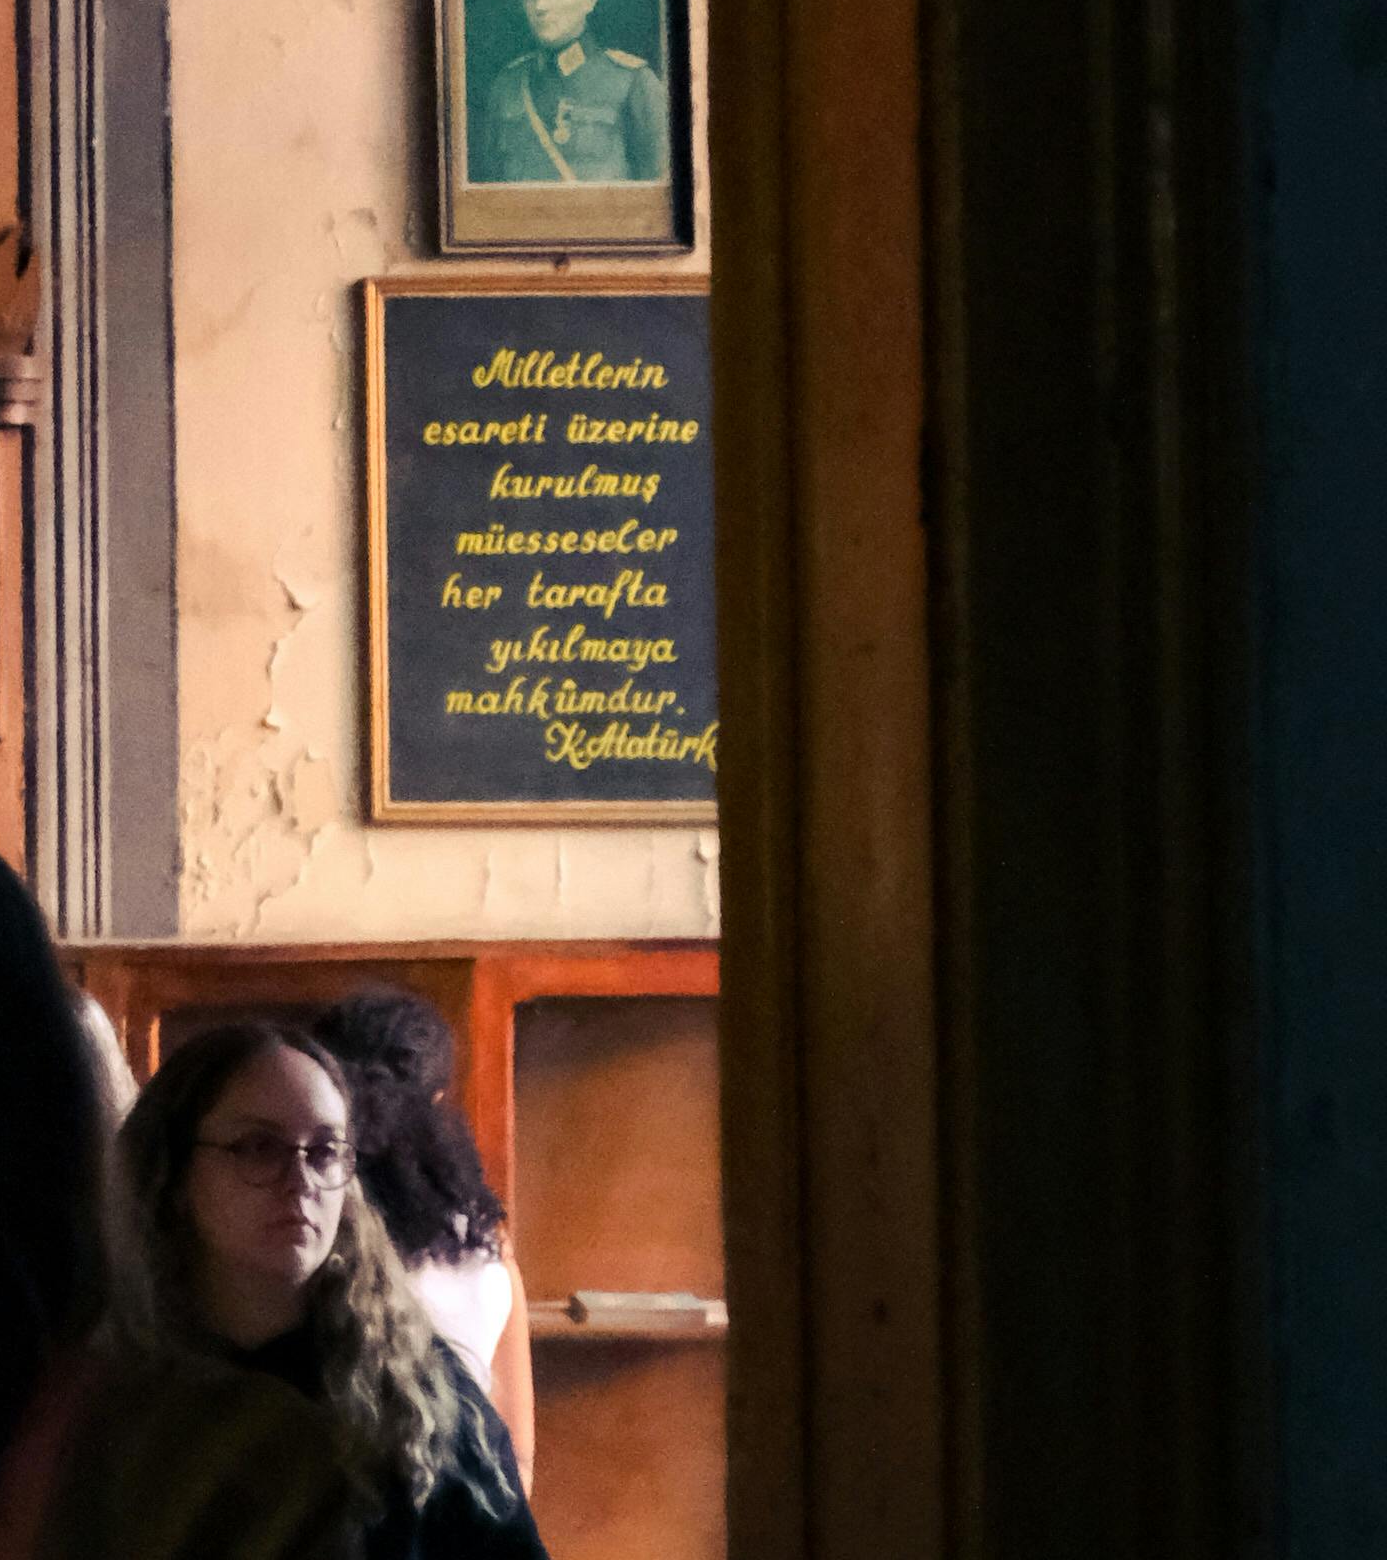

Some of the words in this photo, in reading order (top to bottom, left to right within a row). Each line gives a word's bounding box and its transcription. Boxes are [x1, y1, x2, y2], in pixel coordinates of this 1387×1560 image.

[472, 347, 669, 390] Milletlerin
[422, 412, 548, 446] esareti
[565, 411, 700, 445] üzerine
[489, 462, 662, 504] kurulmuş
[455, 518, 679, 555] müesseseler
[441, 572, 504, 610] her
[526, 569, 669, 620] tarafta
[484, 623, 679, 674] yıkılmaya
